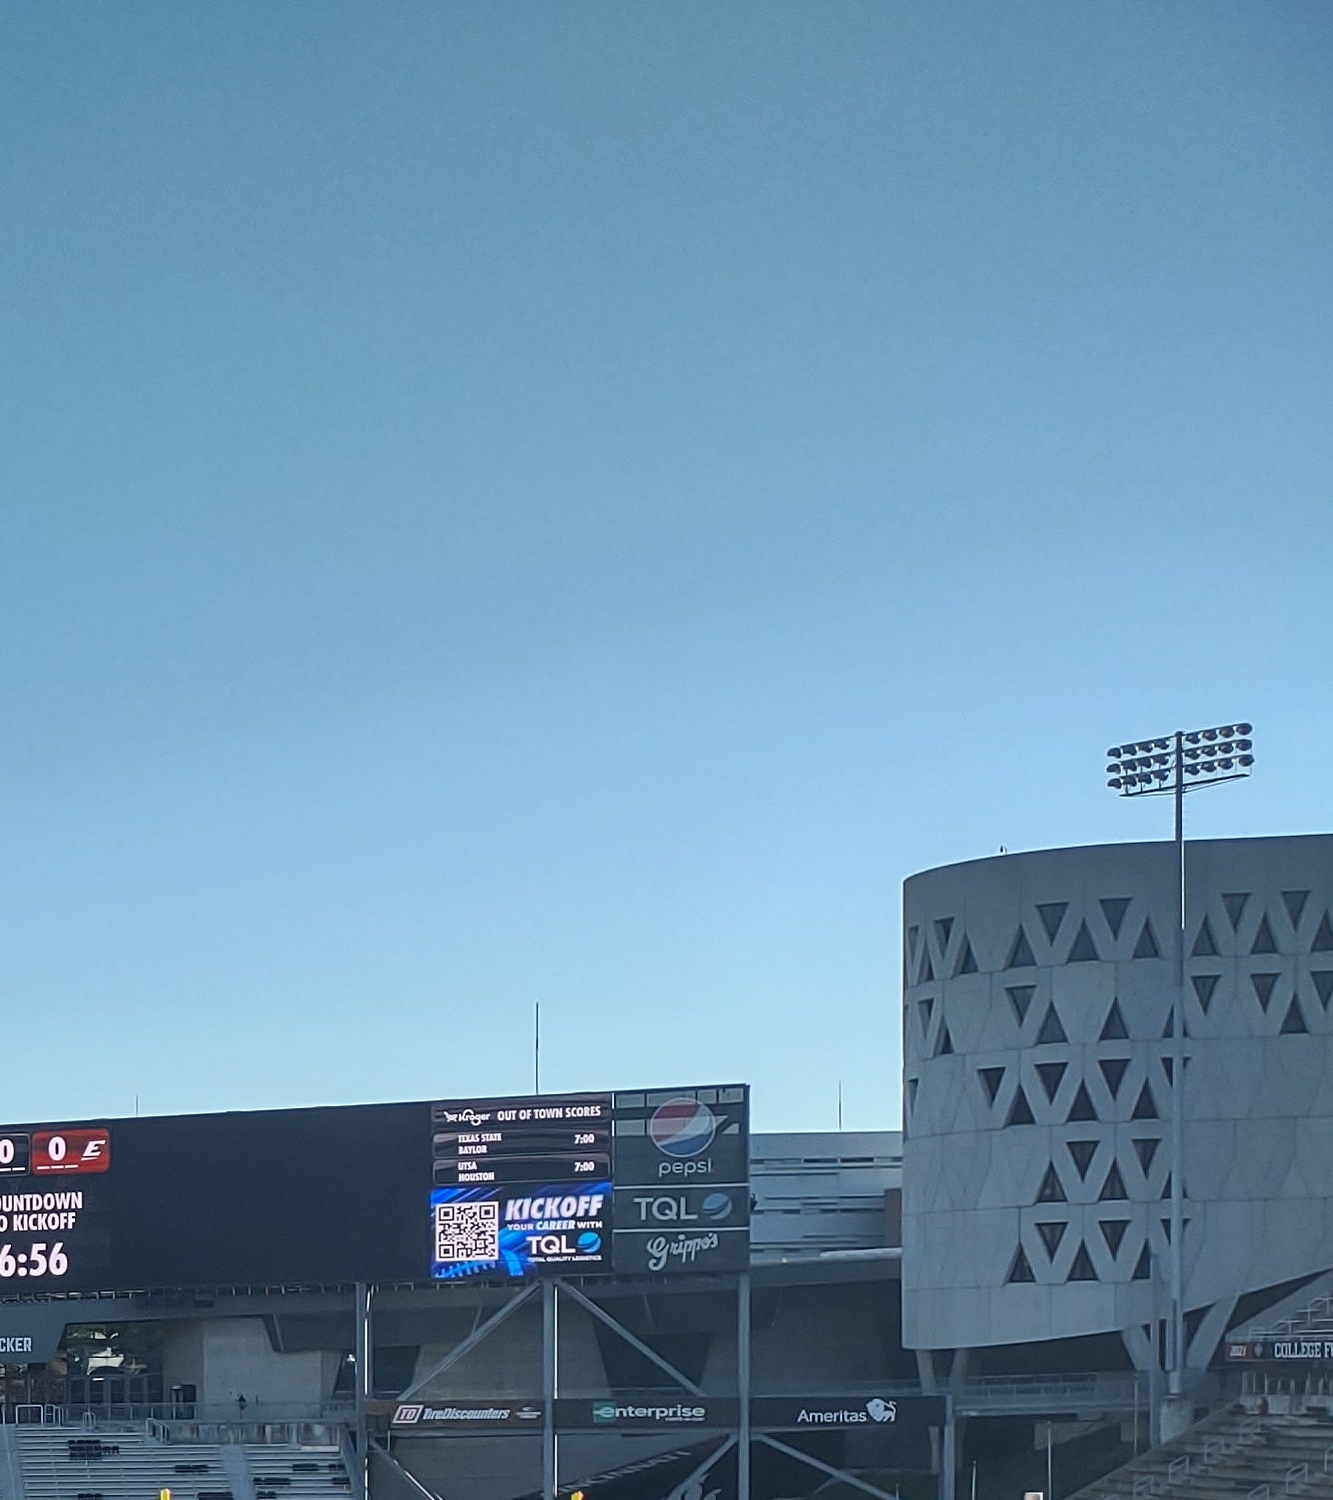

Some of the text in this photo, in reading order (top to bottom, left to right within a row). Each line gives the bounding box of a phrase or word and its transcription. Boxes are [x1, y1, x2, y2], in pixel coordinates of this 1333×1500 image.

[458, 1105, 601, 1127] Kroger OUT OF TOWN SCORES
[458, 1133, 595, 1145] TEXAS STATE 7:00
[48, 1136, 67, 1161] 0
[458, 1145, 488, 1155] BAYLOR
[458, 1161, 595, 1173] UTSA 7:00
[658, 1158, 713, 1177] pepsi
[458, 1172, 495, 1182] HOUSTON
[505, 1194, 604, 1221] KICKOFF
[633, 1196, 699, 1222] TQL
[12, 1211, 77, 1232] KICKOFF
[507, 1220, 603, 1231] YOUR CAREER WITH
[526, 1235, 577, 1255] TQL
[546, 1255, 572, 1263] QUALITY
[1274, 1342, 1322, 1359] COLLEGE
[422, 1406, 511, 1421] TireDiscounters
[597, 1403, 707, 1420] enterprise
[797, 1409, 867, 1423] Ameritas
